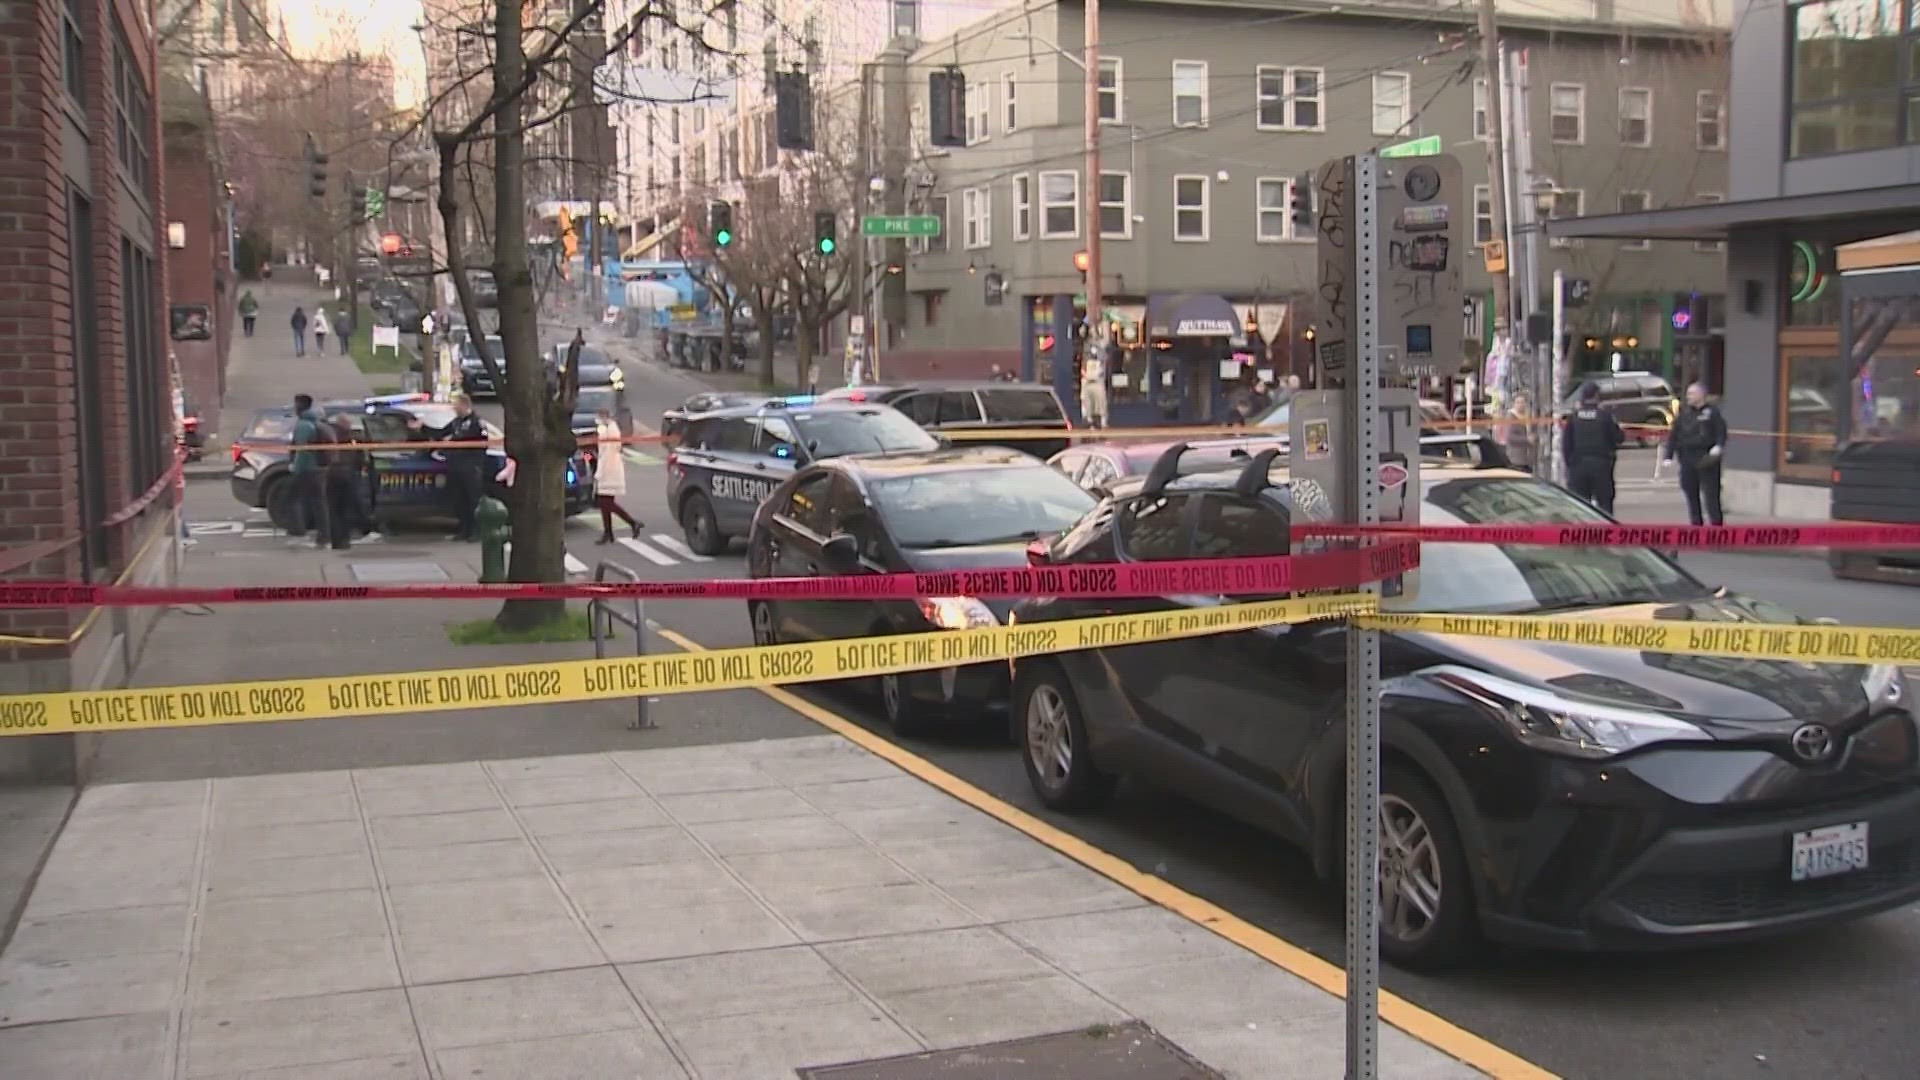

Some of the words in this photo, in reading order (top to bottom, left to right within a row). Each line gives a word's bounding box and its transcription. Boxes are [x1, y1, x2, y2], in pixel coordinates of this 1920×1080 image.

[885, 220, 911, 232] PIKE
[380, 472, 433, 489] POLICE
[711, 475, 750, 501] SEATTLE
